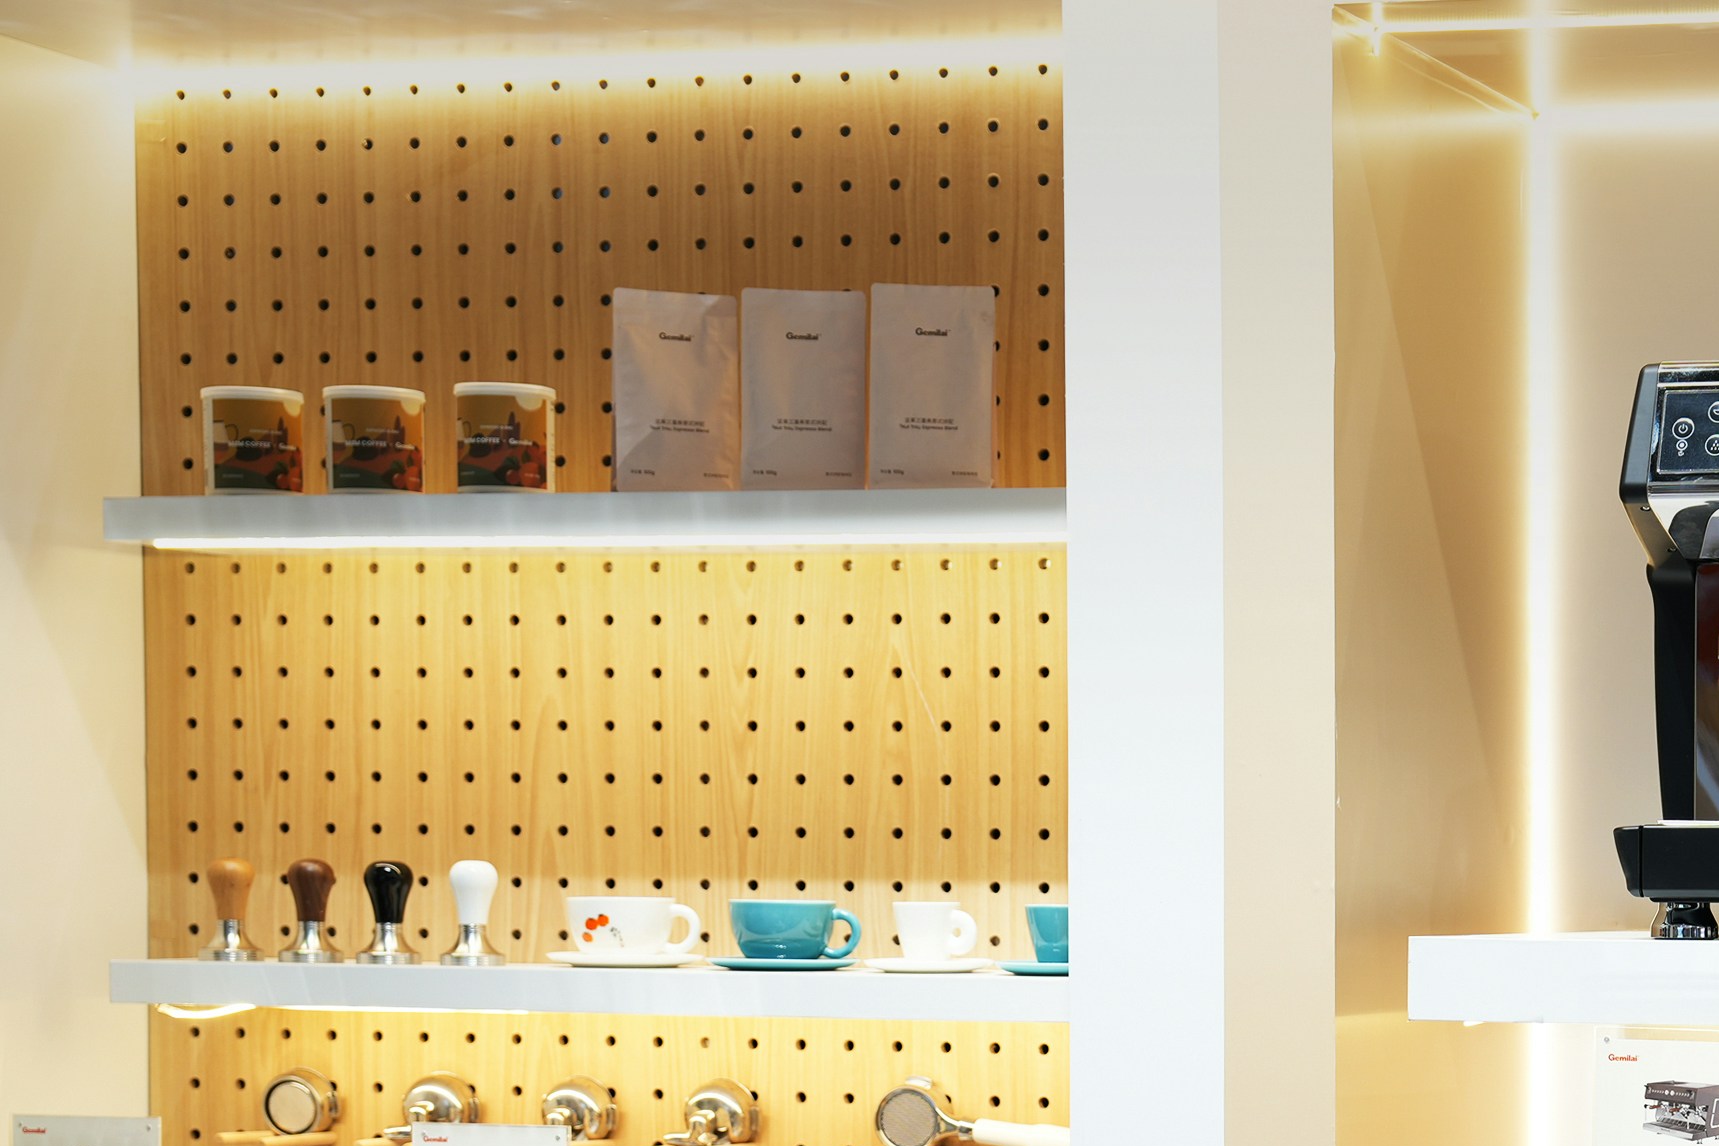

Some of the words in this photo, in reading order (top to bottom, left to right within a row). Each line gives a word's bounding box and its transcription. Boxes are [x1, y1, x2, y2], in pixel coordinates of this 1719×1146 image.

[659, 331, 692, 342] Gemilai
[786, 331, 819, 341] Gemilai
[915, 327, 948, 337] Gemilai
[1608, 1053, 1638, 1062] Gemilai
